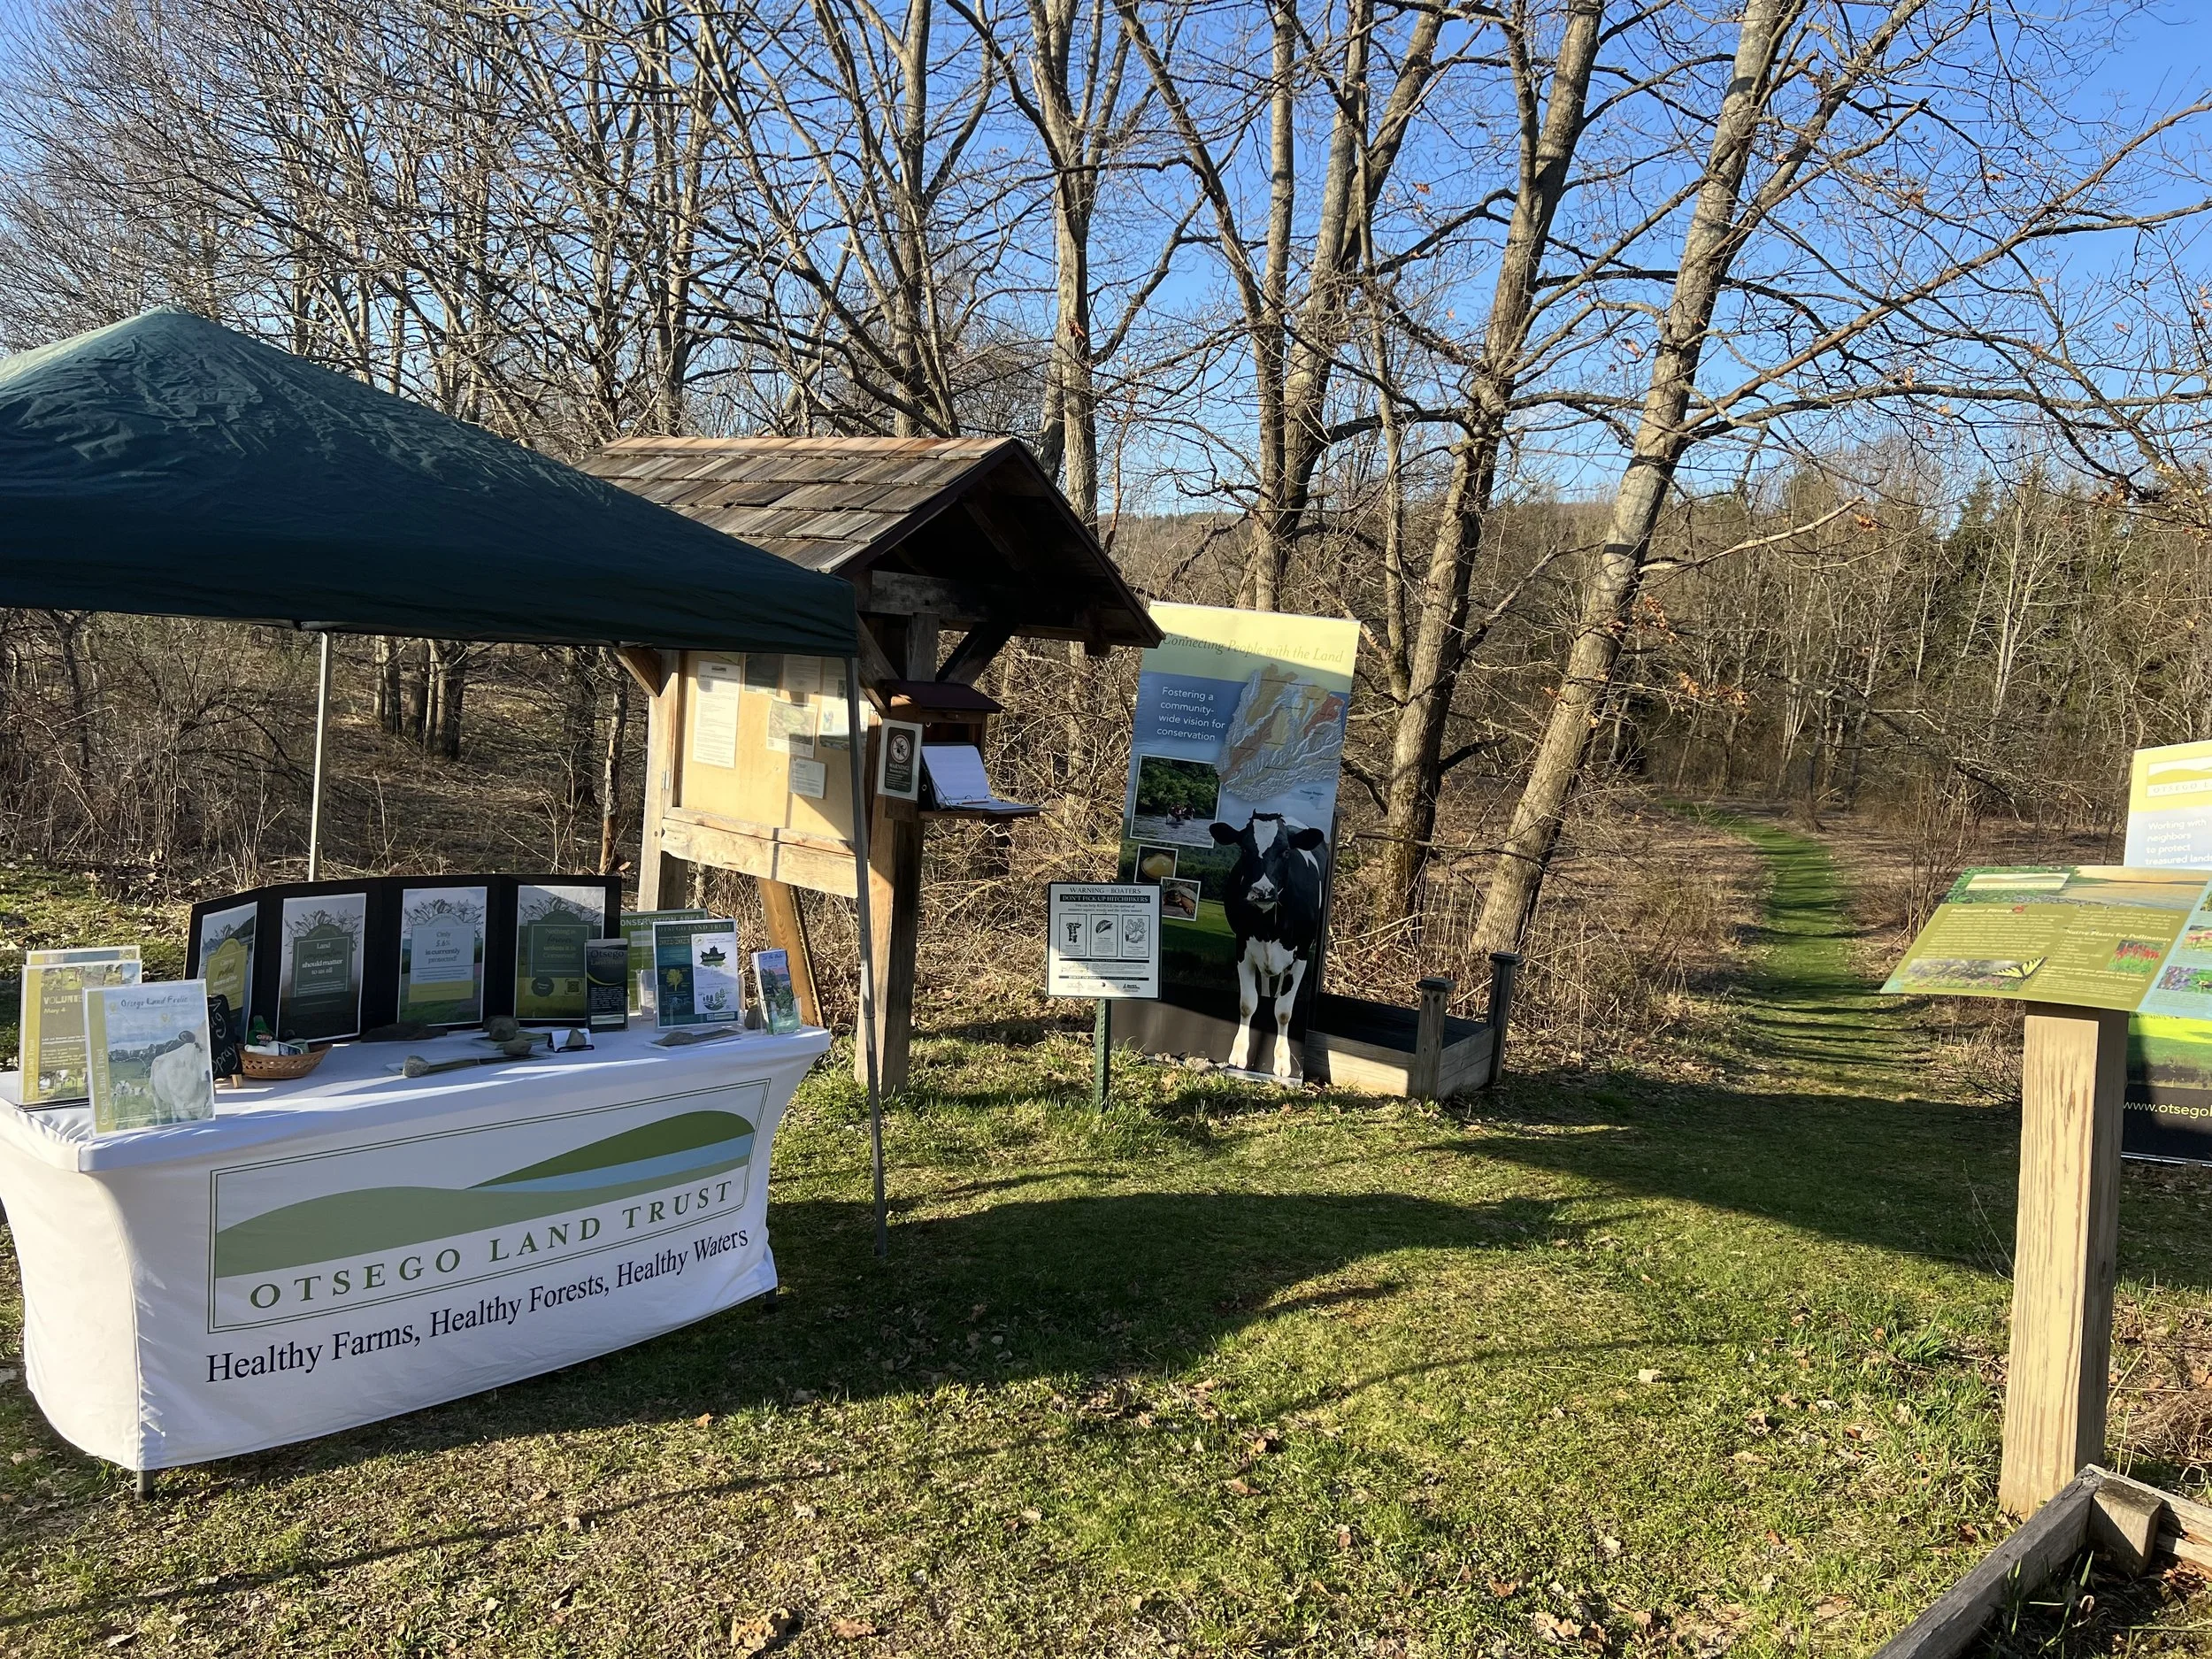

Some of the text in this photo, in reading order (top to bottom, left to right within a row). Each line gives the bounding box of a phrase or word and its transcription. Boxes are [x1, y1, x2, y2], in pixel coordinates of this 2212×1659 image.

[1164, 633, 1344, 663] Connecting People with the Land
[1162, 687, 1206, 702] Fostering
[1160, 701, 1214, 716] community-
[1158, 714, 1225, 730] wide vision for
[1156, 727, 1216, 741] conservation
[2153, 783, 2198, 794] OTSEGO
[2148, 818, 2207, 831] Working with
[2147, 832, 2192, 843] neighbors
[2158, 844, 2191, 856] protect
[2145, 855, 2188, 865] treasured
[620, 917, 677, 927] ONSERVATION
[2128, 933, 2171, 942] Pollinators
[590, 949, 625, 960] Otsego
[302, 960, 323, 969] should
[43, 995, 83, 1005] VOLUNTE
[147, 996, 165, 1005] Land
[167, 995, 189, 1004] Frolic
[210, 1013, 227, 1039] ug
[96, 1048, 111, 1126] Otsego Land Trust
[250, 1180, 732, 1309] OTSEGO LAND TRUST
[205, 1229, 749, 1382] Healthy Farms, Healthy Forests, Healthy Waters
